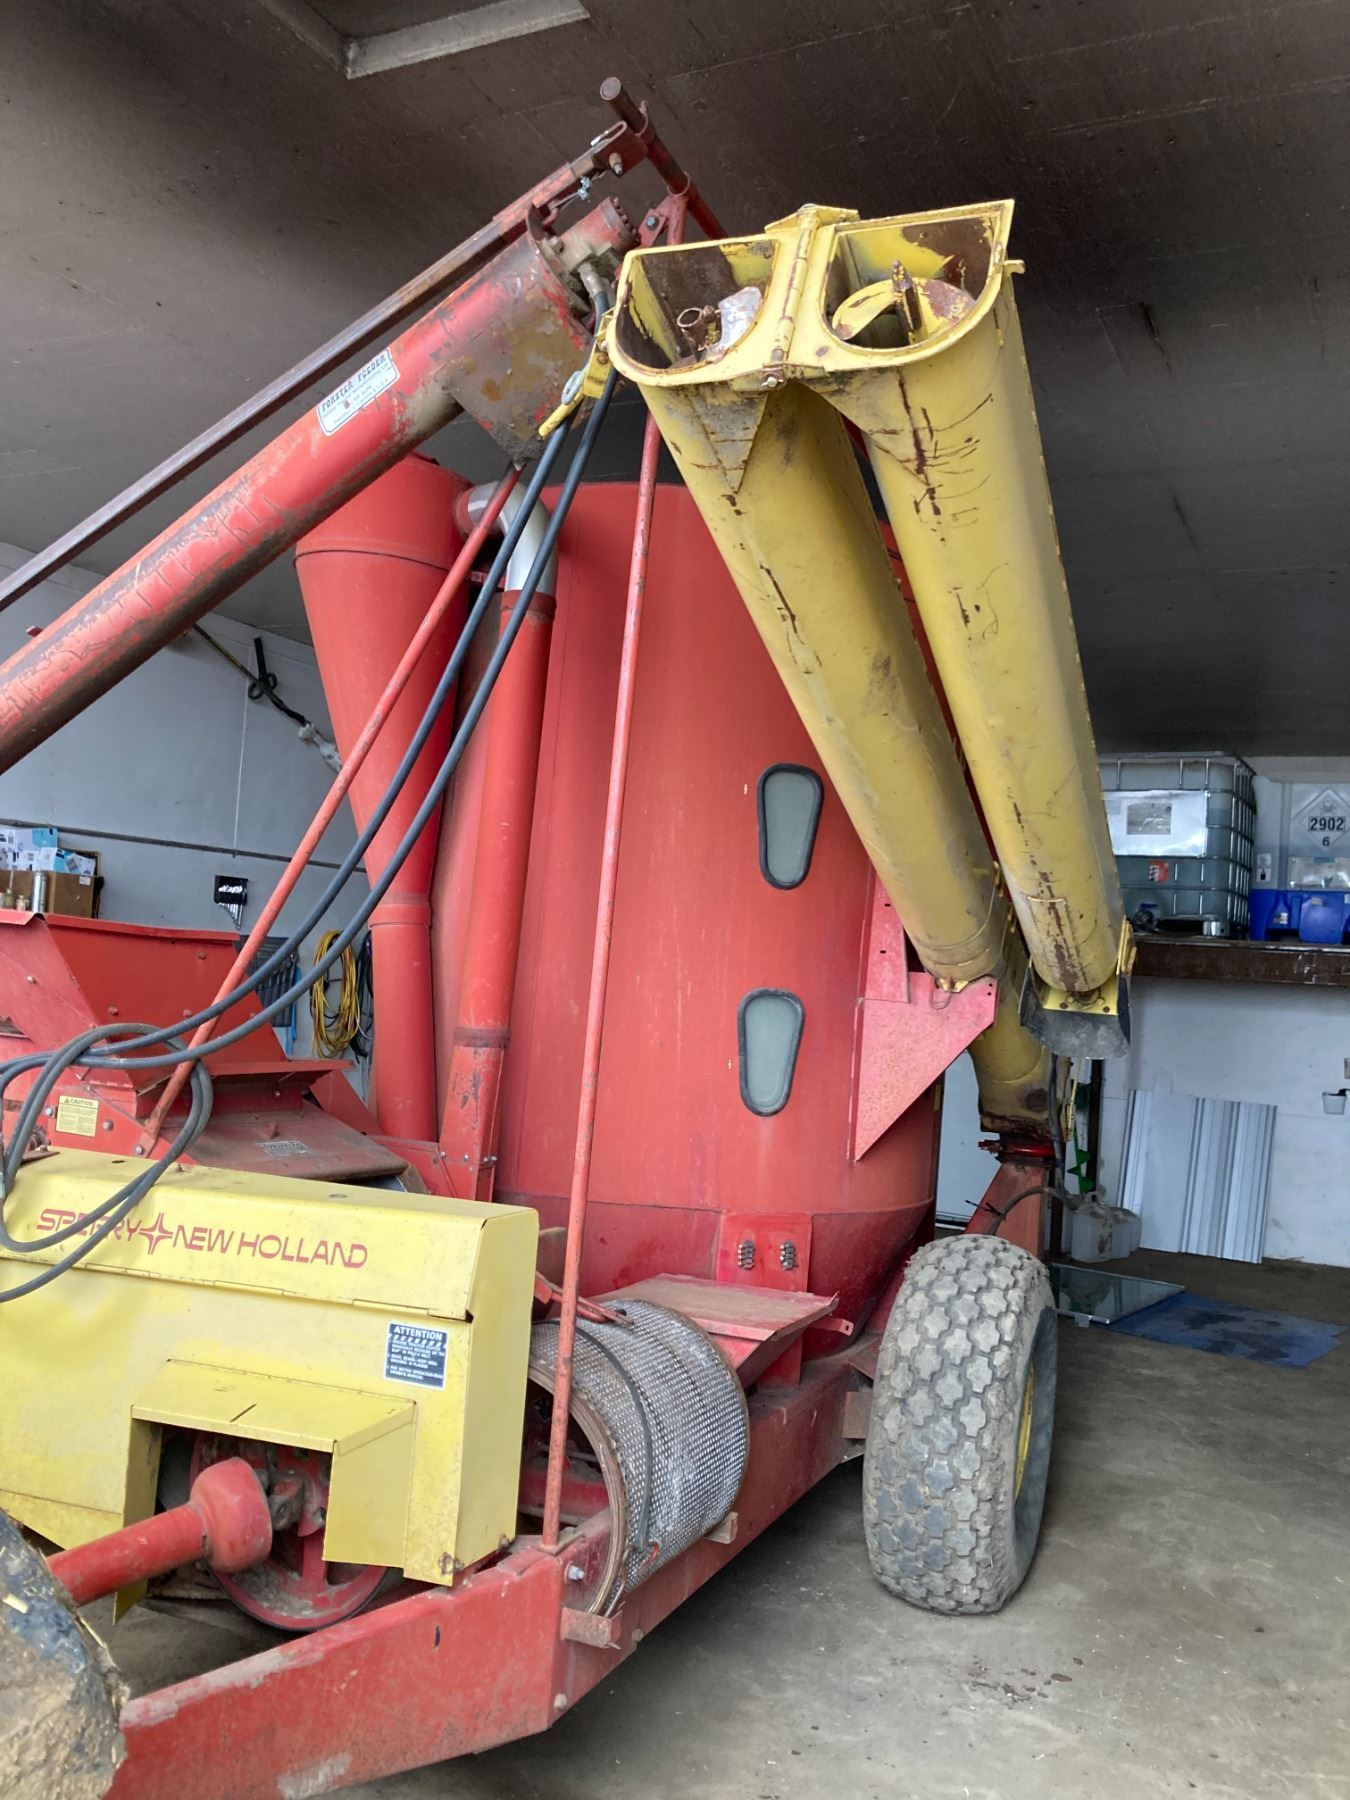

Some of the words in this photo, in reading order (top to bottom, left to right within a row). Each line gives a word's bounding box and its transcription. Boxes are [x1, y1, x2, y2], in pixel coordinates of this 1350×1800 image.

[357, 355, 387, 382] FEEDER
[1310, 817, 1344, 831] 2902
[1322, 836, 1330, 846] 6
[70, 1098, 93, 1106] CAUTION
[173, 1225, 235, 1254] NEW
[237, 1231, 368, 1269] HOLLAND
[394, 1326, 443, 1340] ATTENTION
